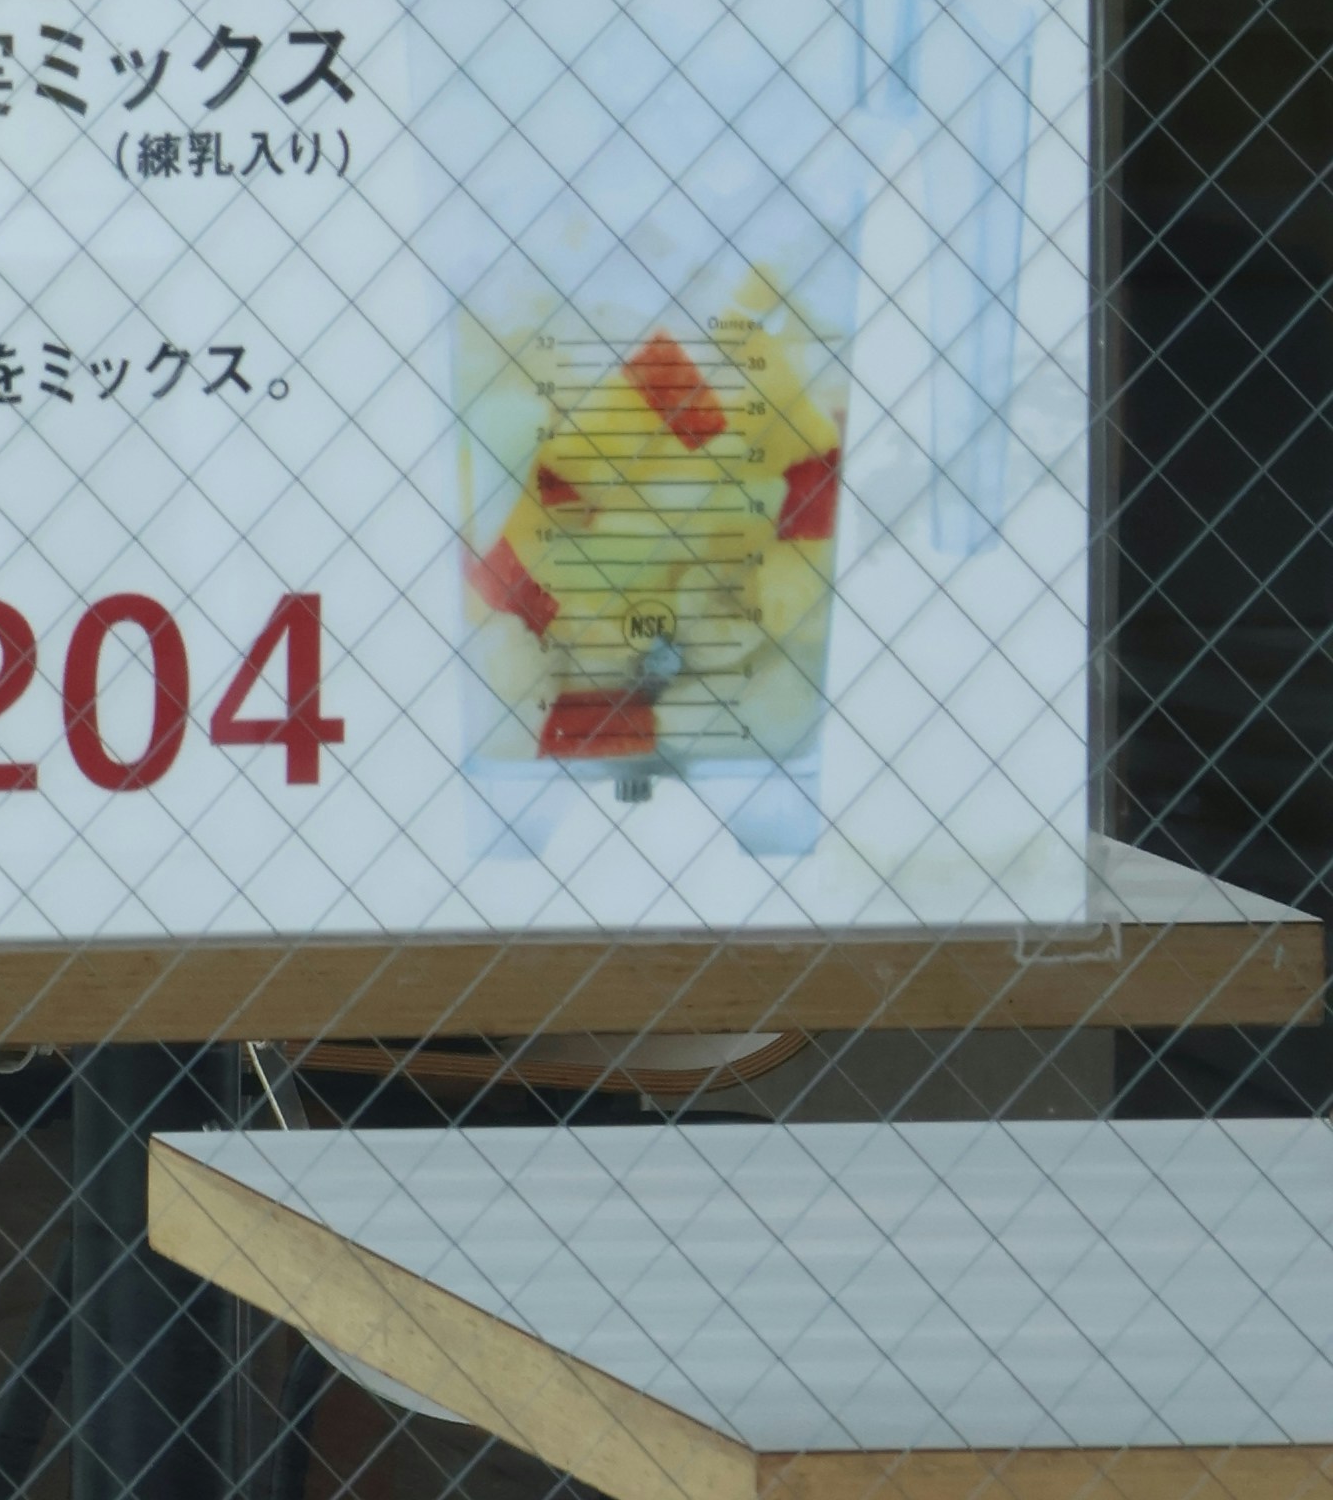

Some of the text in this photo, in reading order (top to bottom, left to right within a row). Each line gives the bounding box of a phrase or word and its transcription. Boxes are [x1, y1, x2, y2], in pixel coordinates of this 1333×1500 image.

[112, 126, 354, 182] (練乳入り)
[747, 356, 766, 370] 30
[747, 401, 766, 416] 26
[747, 448, 766, 463] 22
[630, 615, 667, 638] NSF
